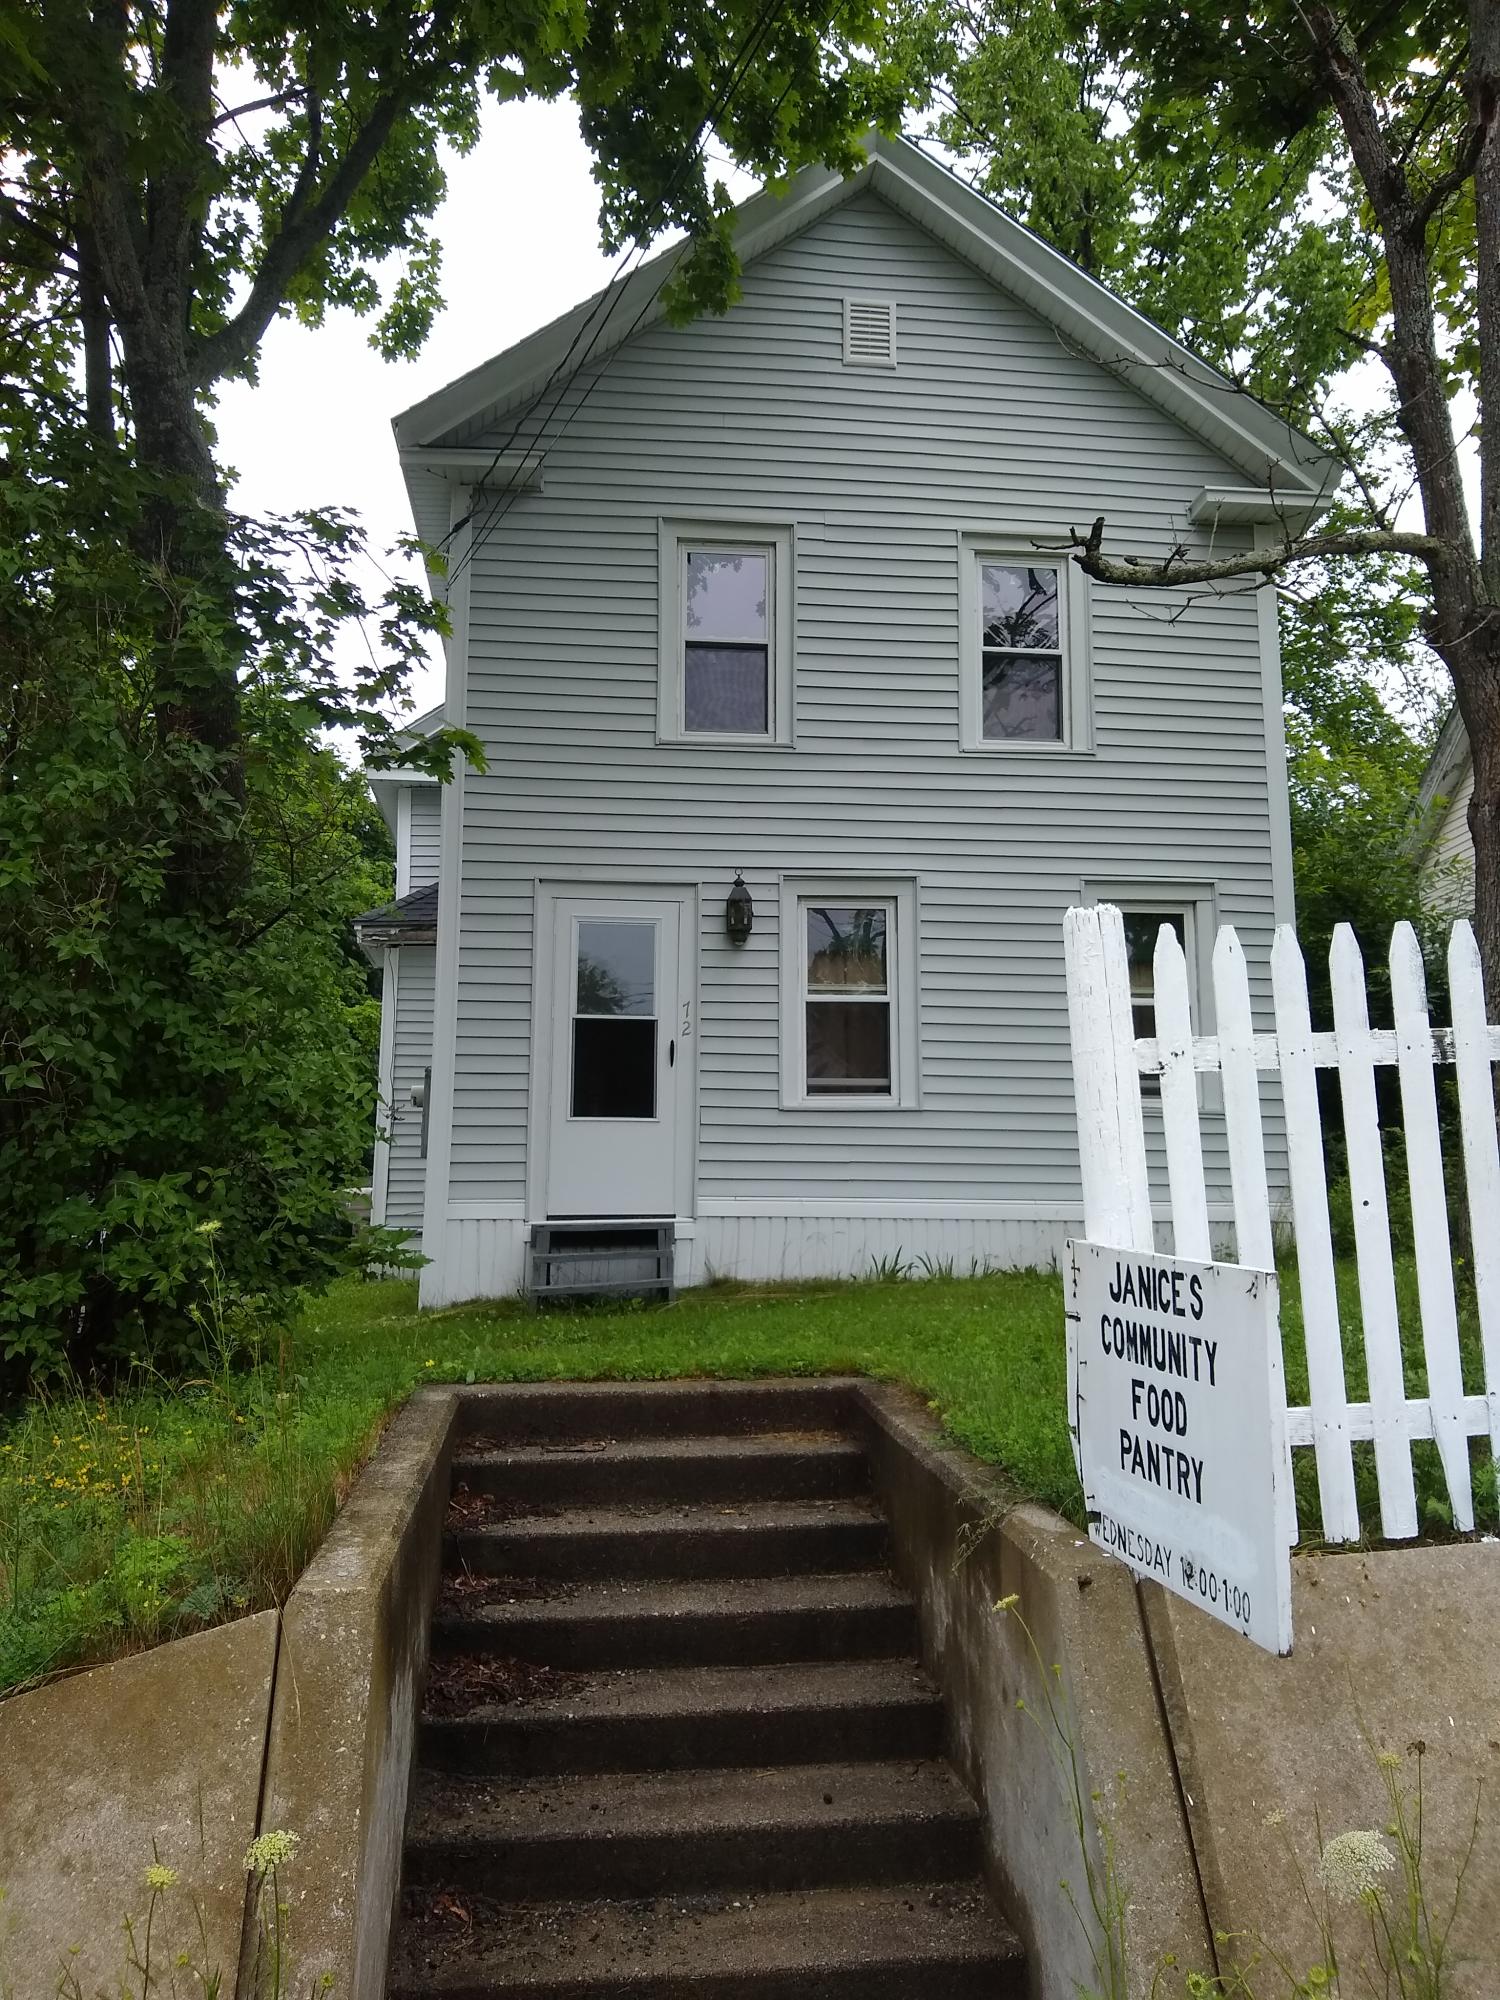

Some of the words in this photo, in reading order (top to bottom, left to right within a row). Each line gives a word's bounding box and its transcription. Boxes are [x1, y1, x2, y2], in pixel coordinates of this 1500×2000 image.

[1109, 1261, 1204, 1321] JANICE'S
[1101, 1314, 1218, 1387] COMMUNITY
[1131, 1378, 1188, 1437] FOOD
[1119, 1428, 1204, 1505] PANTRY
